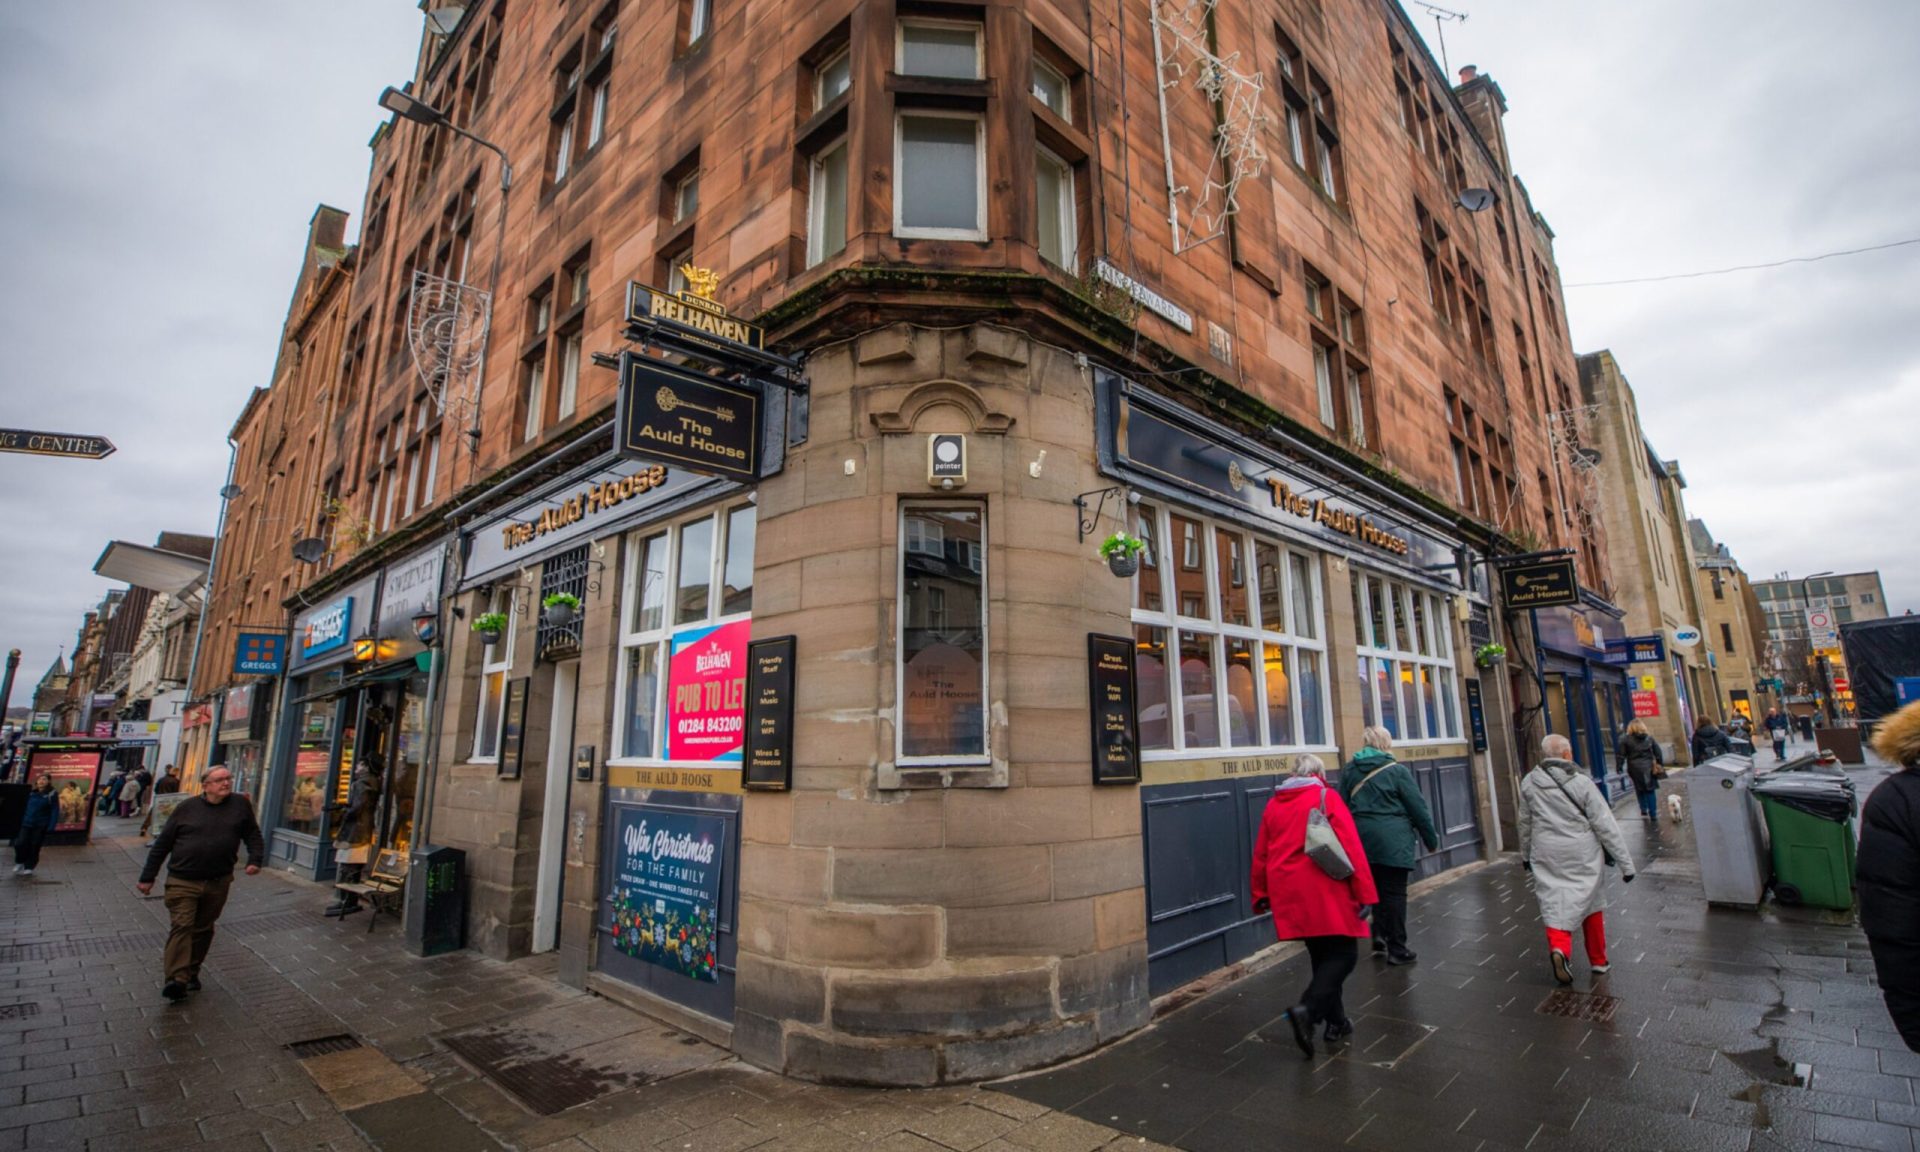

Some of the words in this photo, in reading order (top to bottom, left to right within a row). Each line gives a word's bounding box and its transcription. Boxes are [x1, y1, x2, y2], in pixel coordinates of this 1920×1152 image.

[686, 295, 722, 314] DUNBAR
[651, 294, 750, 345] BELHAVEN
[679, 416, 712, 436] The
[29, 435, 100, 453] CENTRE
[639, 424, 684, 446] Auld
[690, 435, 746, 460] Hoose
[935, 463, 961, 471] pointer
[502, 522, 534, 550] The
[536, 492, 583, 535] Auld
[587, 463, 668, 515] Hoose
[1266, 477, 1310, 518] The
[1313, 499, 1358, 535] Auld
[1360, 517, 1408, 555] Hoose
[1512, 593, 1534, 601] Auld
[1537, 590, 1570, 598] Hoose
[696, 651, 732, 673] BELHAVEN
[1635, 650, 1658, 660] HILL
[241, 661, 277, 670] GREGGS
[675, 683, 701, 714] PUB
[705, 681, 720, 711] TO
[724, 677, 747, 710] LET
[1107, 684, 1121, 692] Free
[759, 697, 778, 705] Music
[678, 718, 704, 734] 01284
[707, 716, 742, 732] 843200
[761, 718, 775, 726] Free
[1222, 760, 1239, 774] THE
[1242, 759, 1262, 773] AULD
[1264, 758, 1288, 771] HOOSE
[636, 771, 651, 784] THE
[655, 772, 678, 785] AULD
[682, 773, 713, 787] HOOSE
[624, 819, 651, 856] Win
[652, 829, 715, 864] Christmas
[626, 857, 643, 871] FOR
[647, 861, 665, 877] THE
[668, 865, 705, 884] FAMILY
